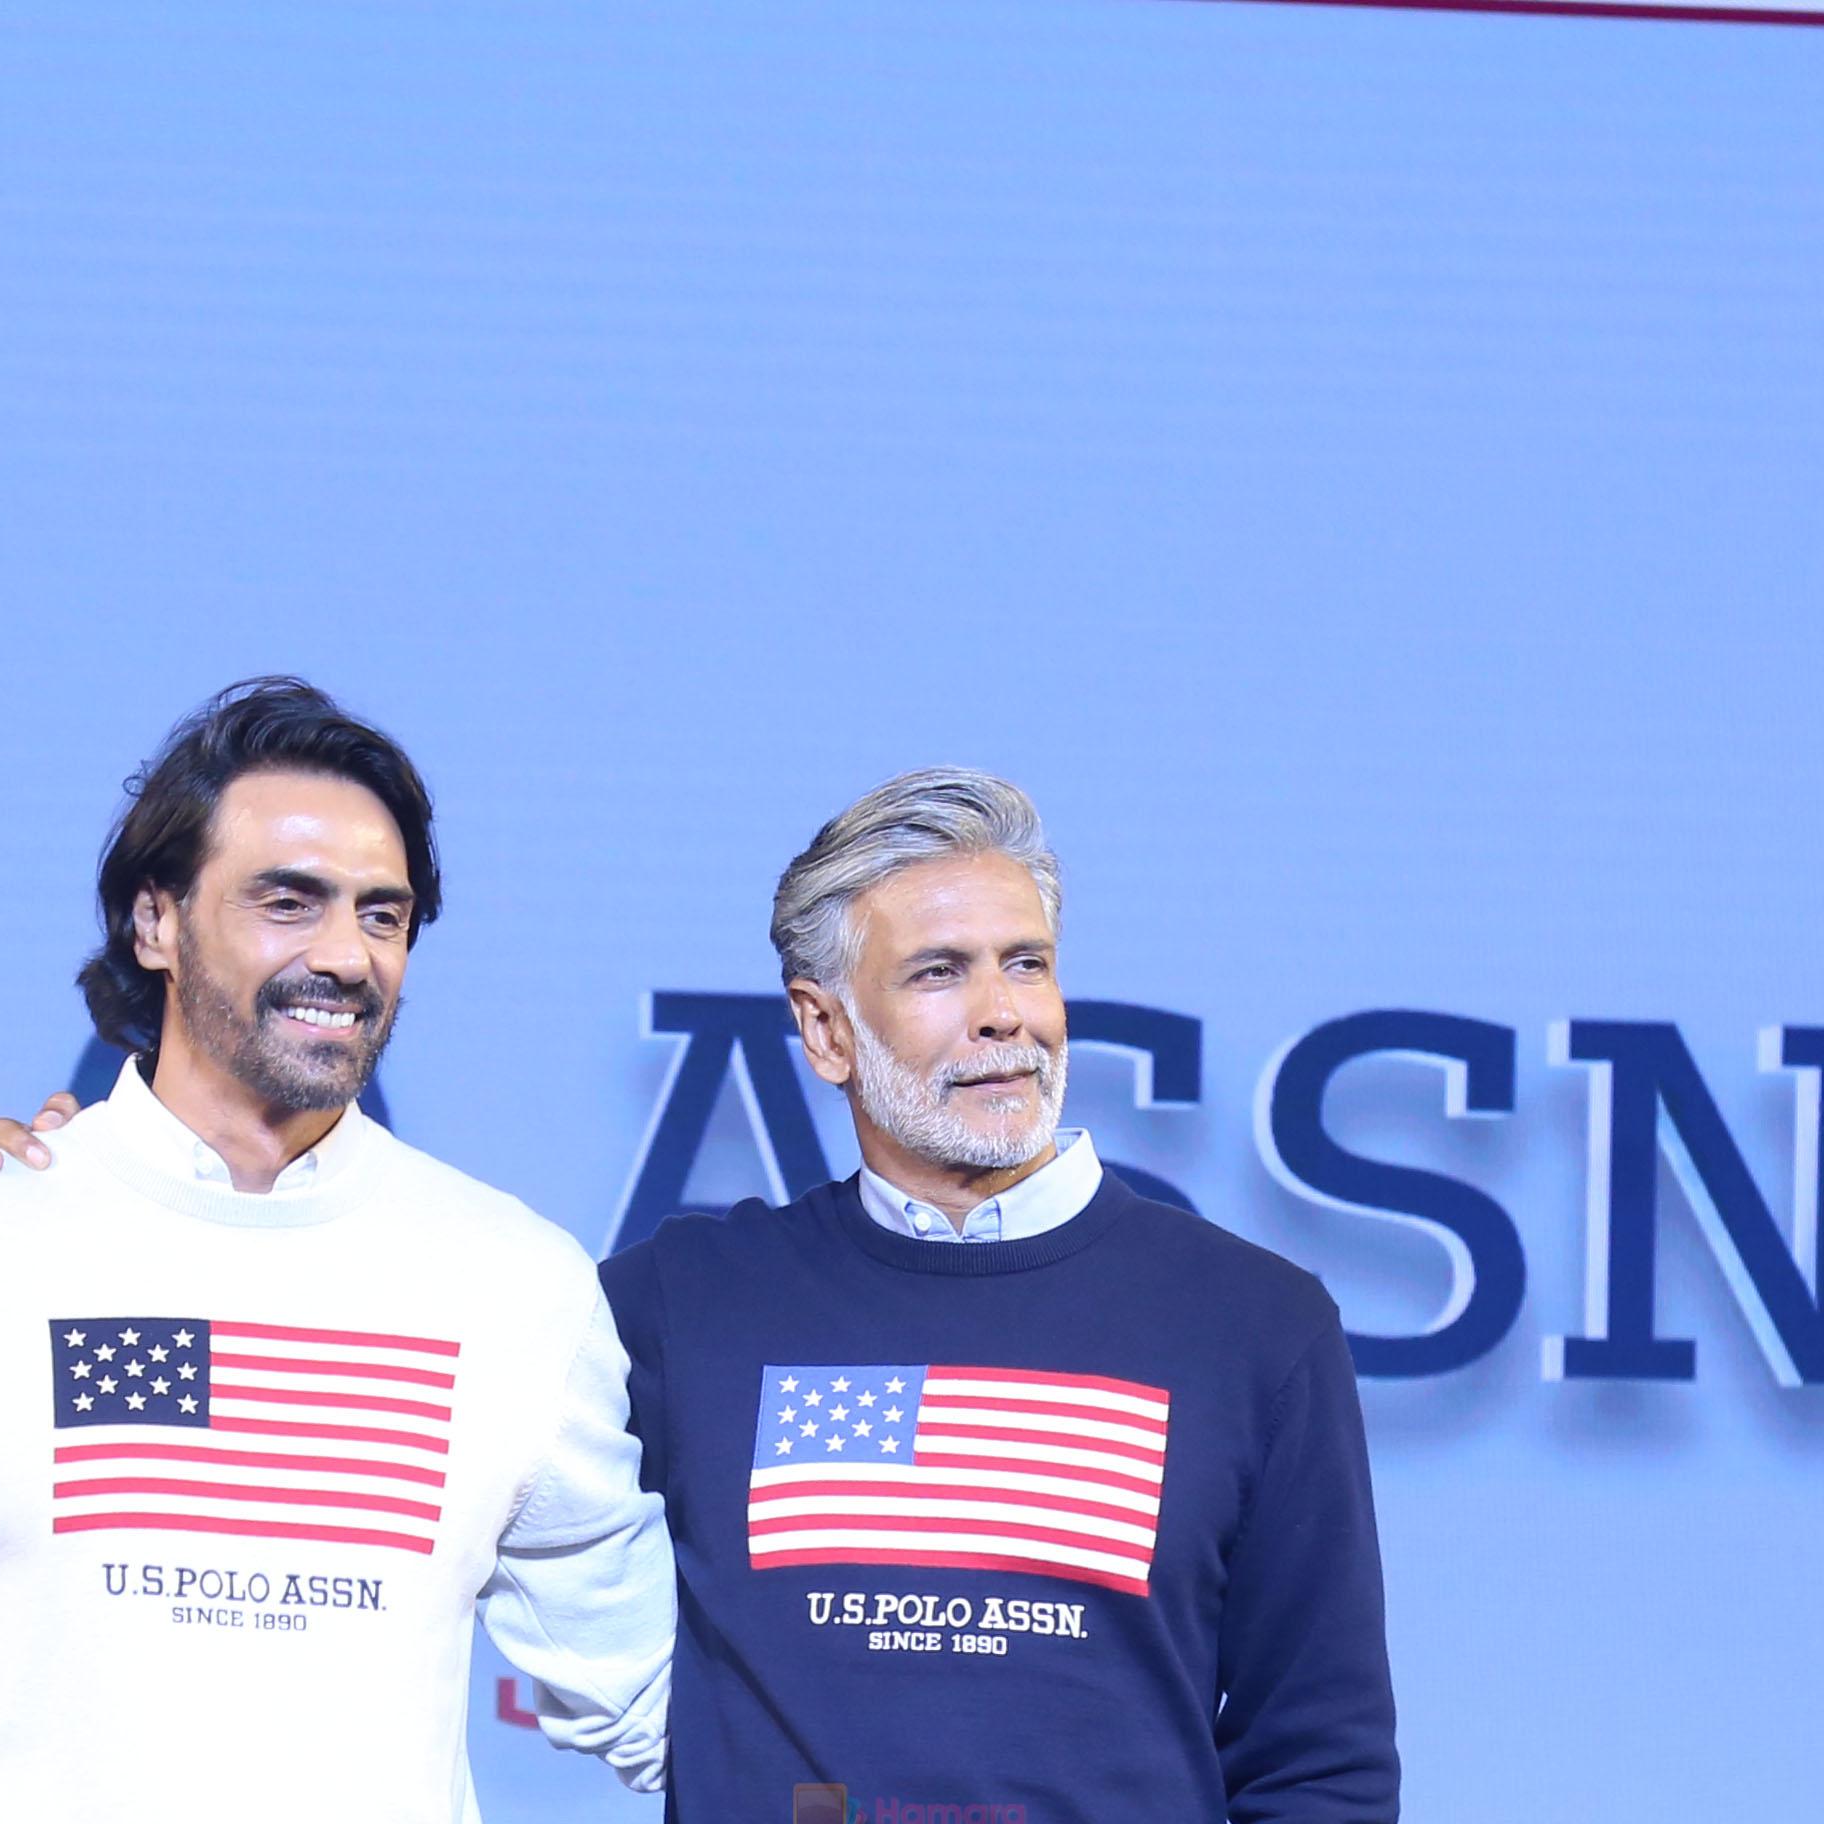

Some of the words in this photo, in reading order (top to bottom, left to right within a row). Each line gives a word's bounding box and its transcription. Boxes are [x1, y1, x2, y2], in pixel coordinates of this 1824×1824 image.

[280, 1574, 388, 1612] ASSN.
[172, 1606, 244, 1628] SINCE
[254, 1612, 308, 1632] 1890
[978, 1597, 1089, 1639] ASSN.
[867, 1631, 943, 1652] SINCE
[951, 1633, 1009, 1656] 1890
